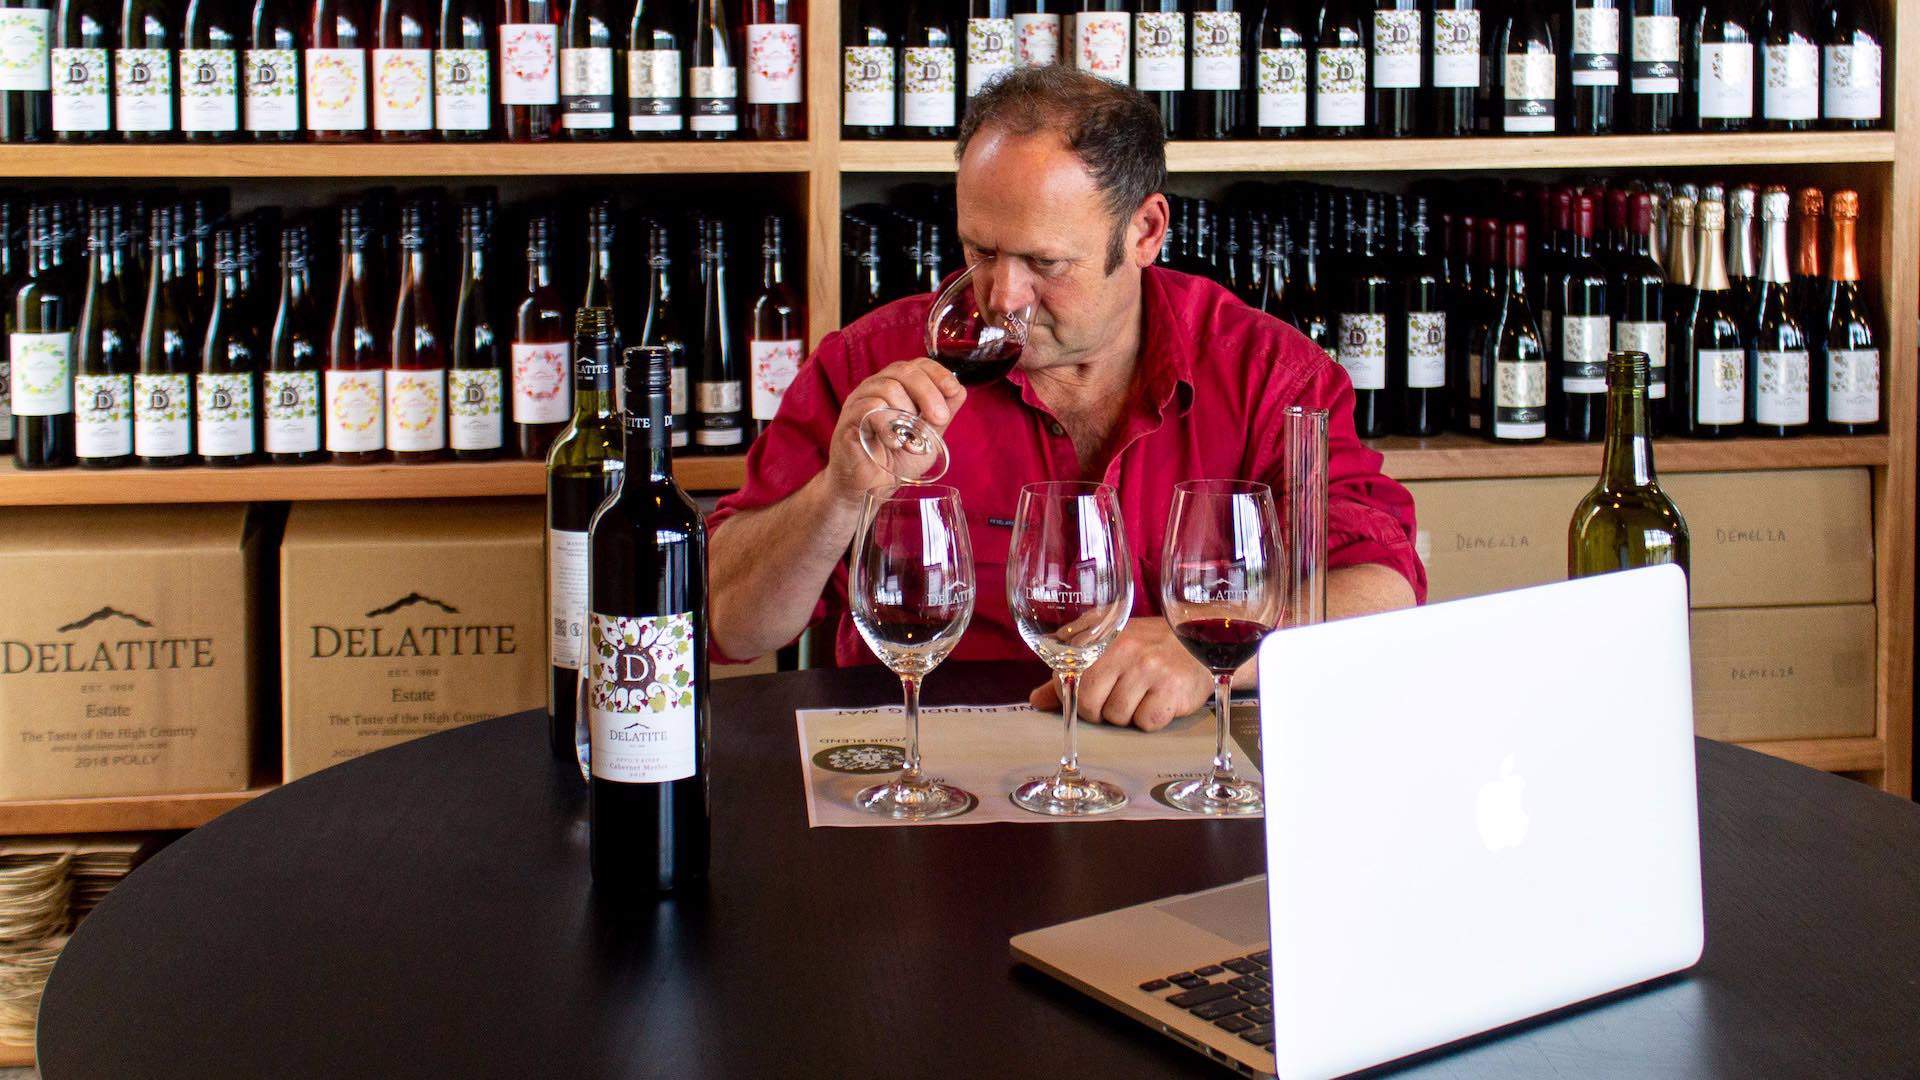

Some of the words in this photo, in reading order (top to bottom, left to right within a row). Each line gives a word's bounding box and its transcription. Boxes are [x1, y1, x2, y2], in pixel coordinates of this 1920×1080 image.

[576, 364, 609, 375] LATITE
[311, 625, 516, 659] DELATITE
[1, 637, 215, 675] DELATITE
[623, 654, 649, 682] D
[391, 688, 436, 703] Estate
[86, 703, 132, 719] Estate
[834, 709, 878, 717] MAT
[887, 706, 998, 716] BLENDIG
[329, 714, 351, 727] The
[355, 714, 385, 728] Taste
[387, 713, 399, 726] of
[402, 713, 420, 726] the
[423, 712, 450, 727] High
[22, 731, 43, 743] The
[48, 730, 77, 742] Taste
[81, 728, 94, 740] of
[97, 728, 114, 740] the
[118, 727, 147, 741] High
[149, 725, 198, 740] Country
[608, 729, 669, 743] DELATITE
